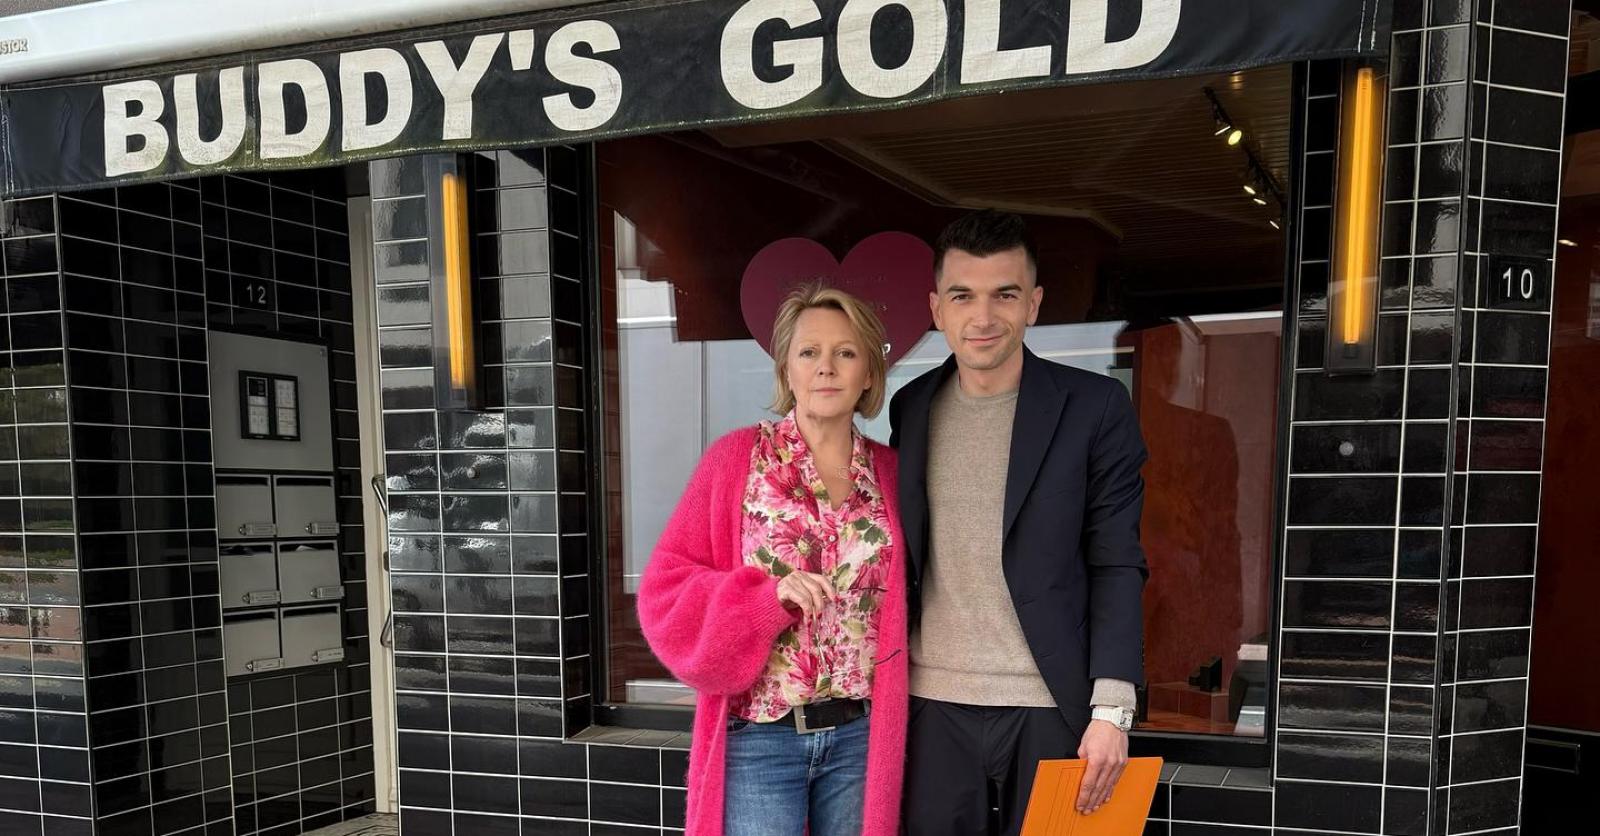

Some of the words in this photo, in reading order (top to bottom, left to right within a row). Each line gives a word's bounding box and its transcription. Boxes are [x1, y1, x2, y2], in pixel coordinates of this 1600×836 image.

[0, 39, 28, 55] STOR
[103, 20, 622, 177] BUDDY'S
[720, 0, 1181, 110] GOLD
[246, 283, 267, 304] 12
[1502, 267, 1534, 299] 10
